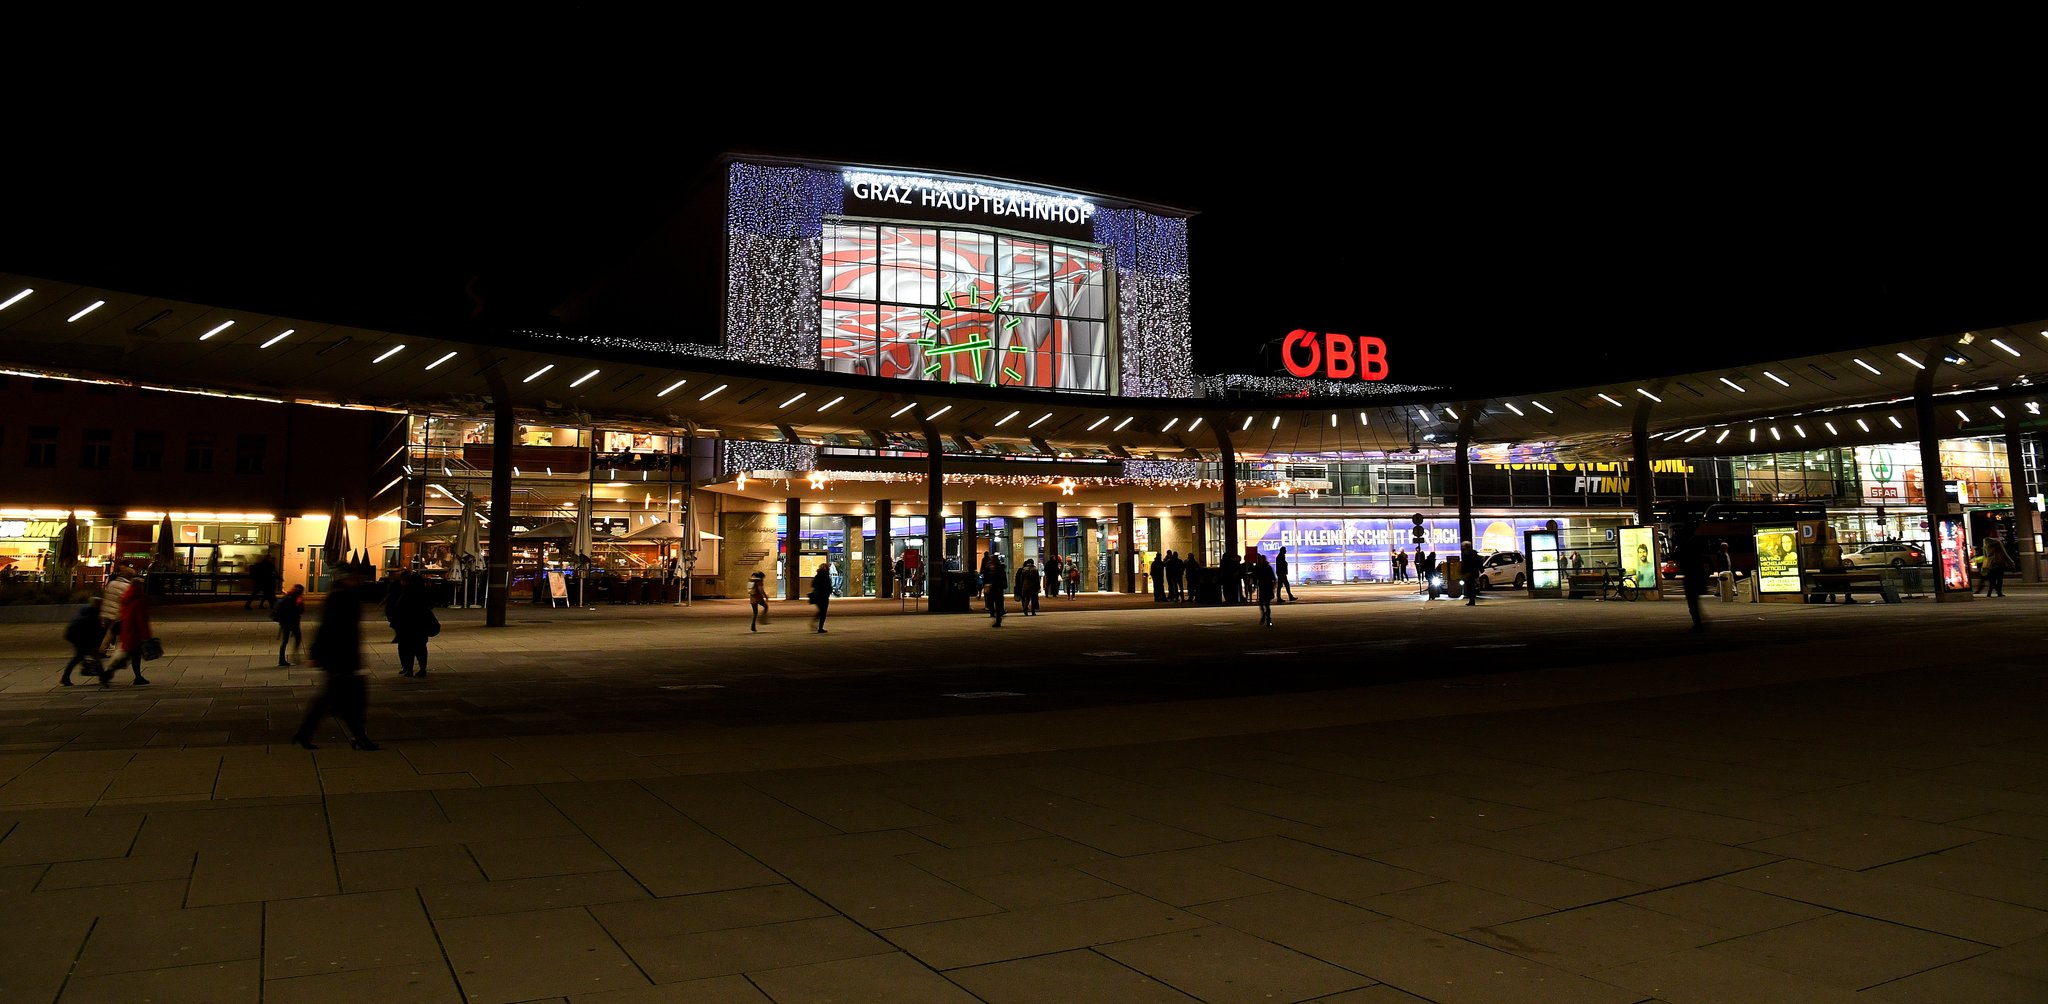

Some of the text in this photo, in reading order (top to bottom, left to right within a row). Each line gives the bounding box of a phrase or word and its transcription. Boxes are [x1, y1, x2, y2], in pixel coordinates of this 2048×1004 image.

[853, 180, 1091, 225] GRAZ HAUPTBAHNHOF
[1282, 329, 1389, 381] ÖBB
[1872, 489, 1897, 497] SPAR
[1281, 529, 1302, 546] EIN
[1408, 528, 1431, 545] FR
[1433, 528, 1458, 545] DICH
[1606, 530, 1614, 541] D
[1803, 525, 1812, 538] D
